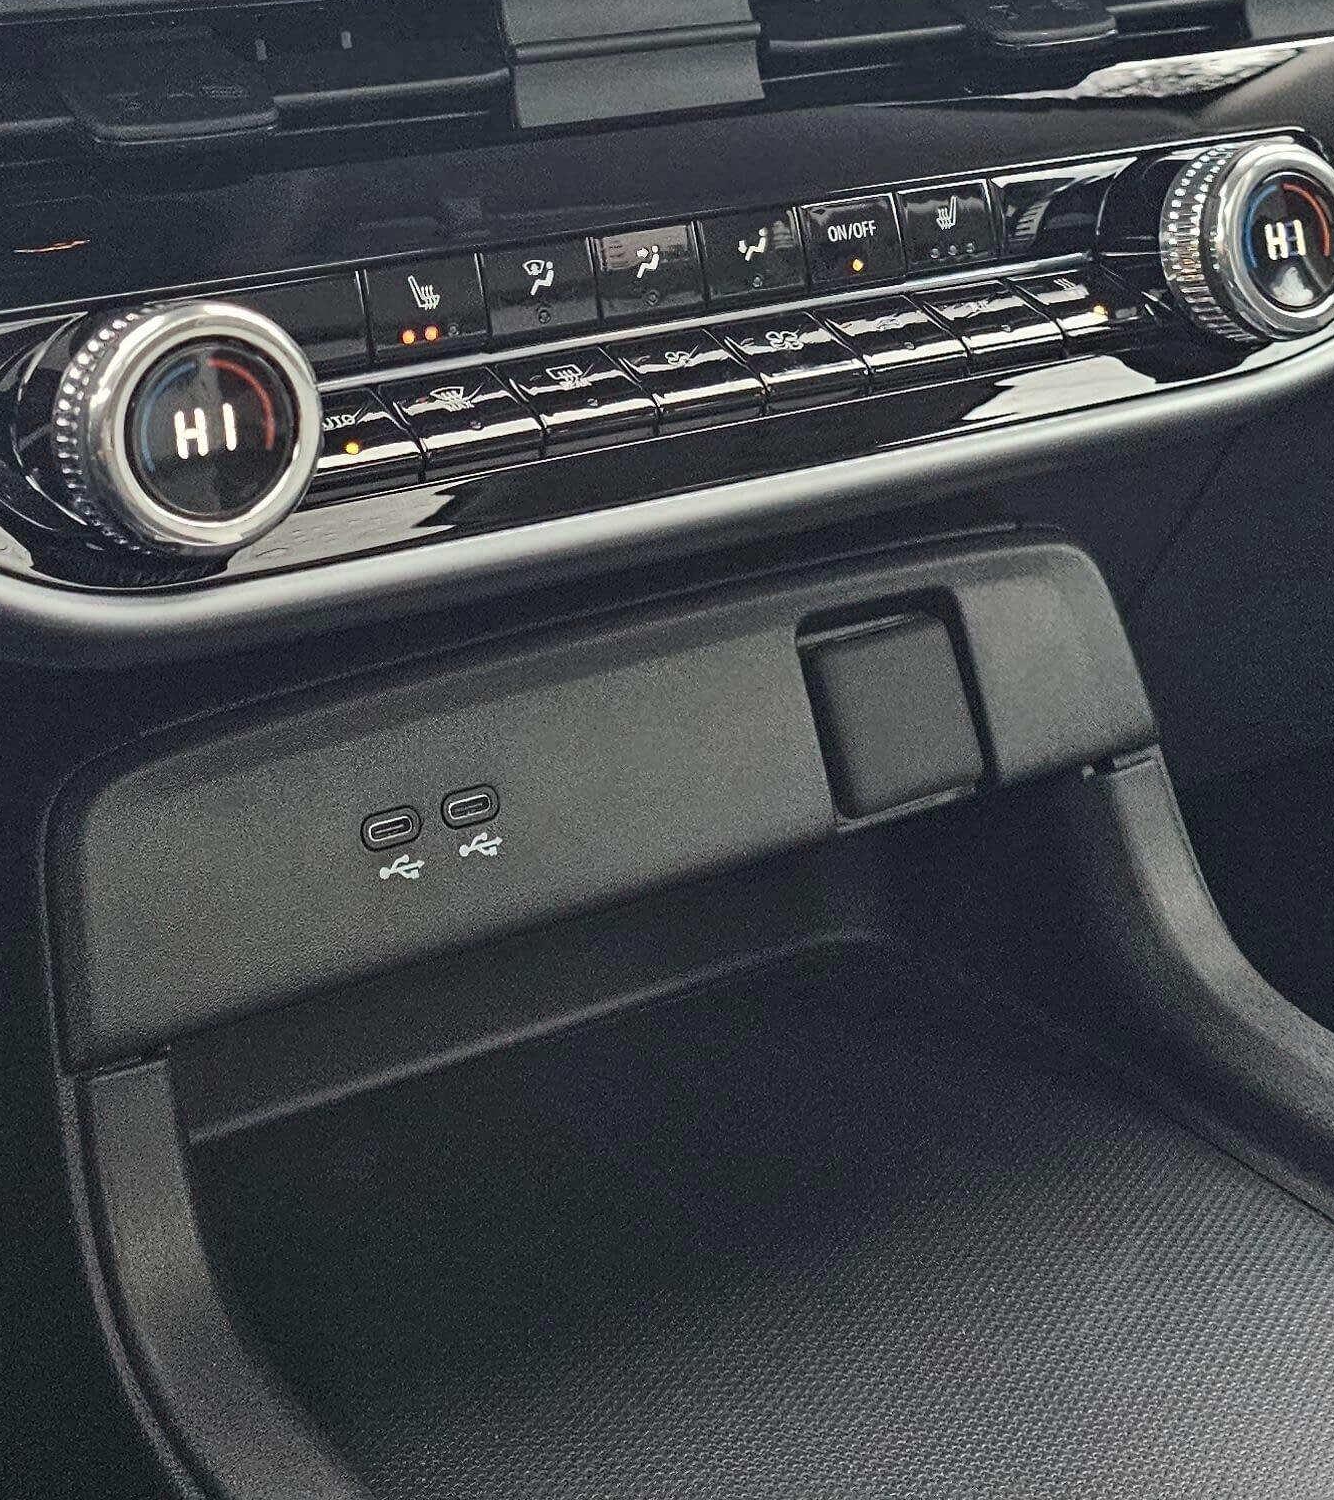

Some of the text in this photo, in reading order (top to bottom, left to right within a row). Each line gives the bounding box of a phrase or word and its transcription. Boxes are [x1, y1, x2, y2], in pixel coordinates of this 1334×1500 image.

[827, 219, 877, 242] ON/OFF
[1264, 219, 1306, 261] HI
[172, 401, 238, 461] HI
